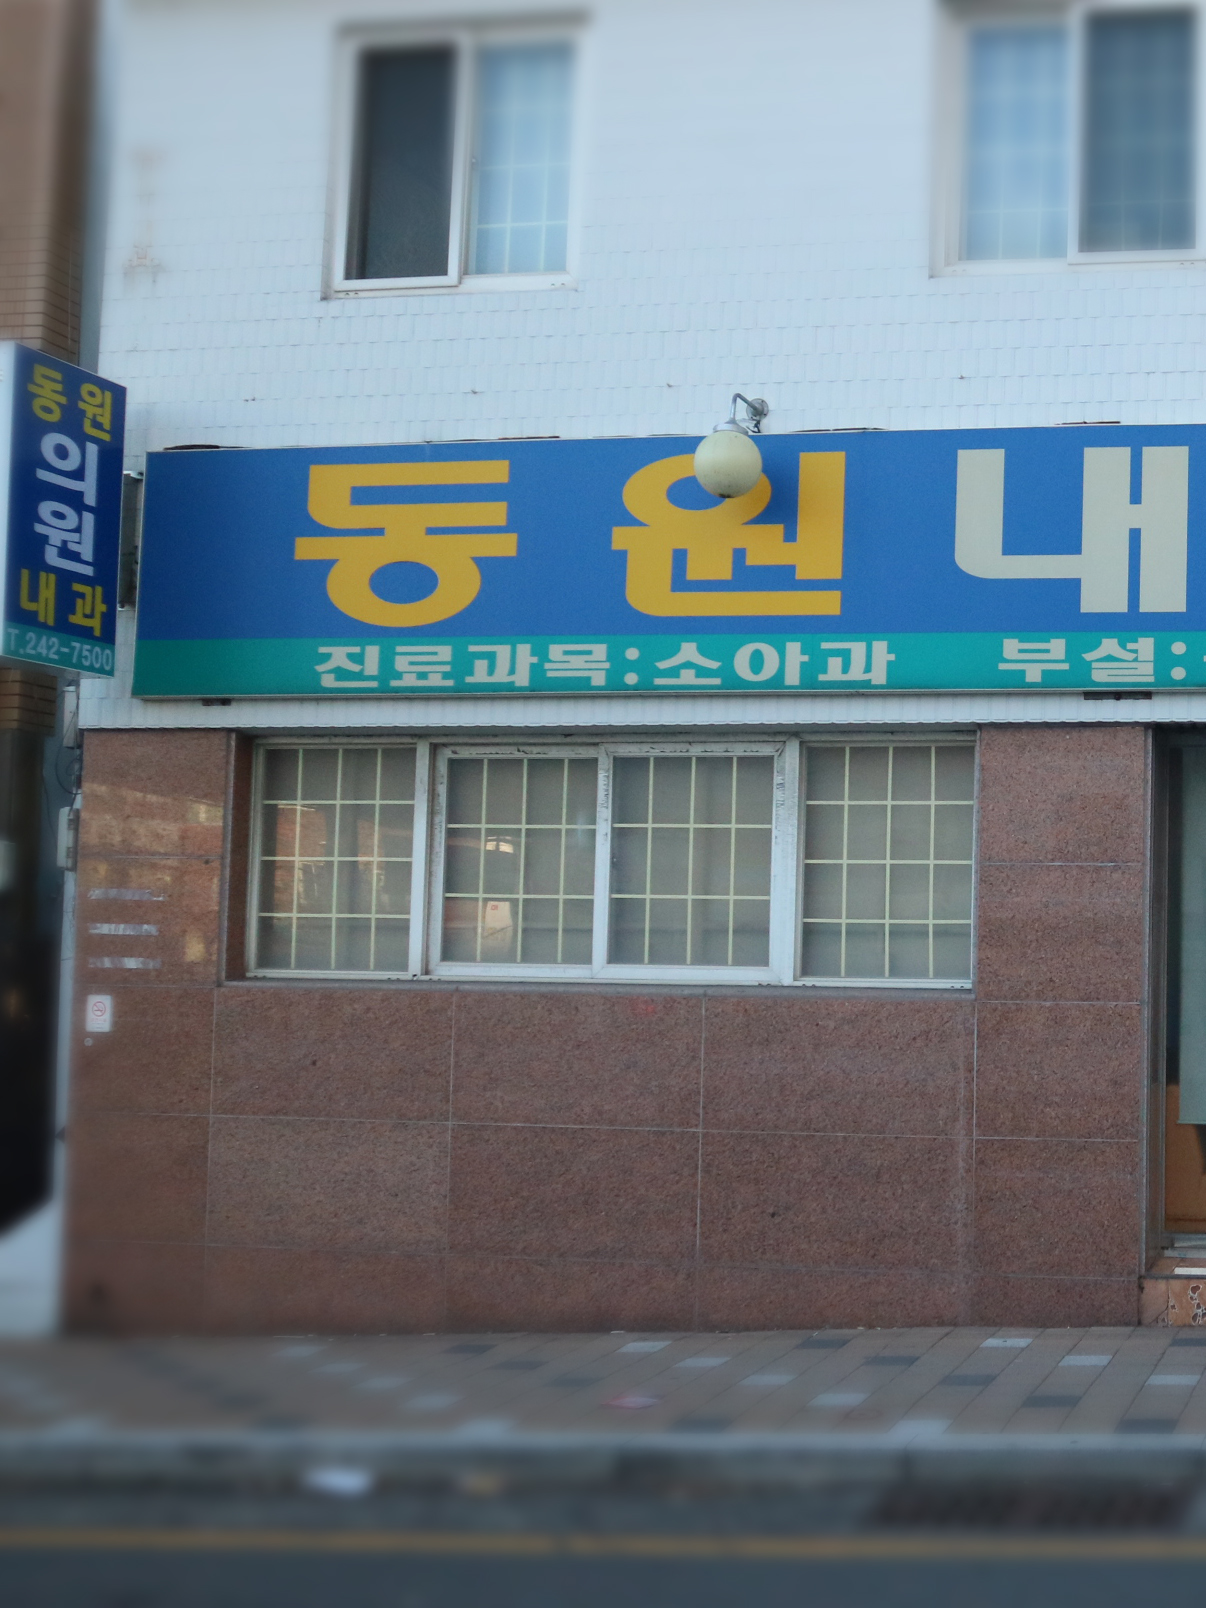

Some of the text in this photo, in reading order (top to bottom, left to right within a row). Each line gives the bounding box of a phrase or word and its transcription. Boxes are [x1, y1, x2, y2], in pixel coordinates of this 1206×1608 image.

[27, 363, 112, 442] 동원
[34, 432, 98, 577] 의원
[20, 568, 107, 637] 내과
[8, 627, 112, 672] T.242-7500
